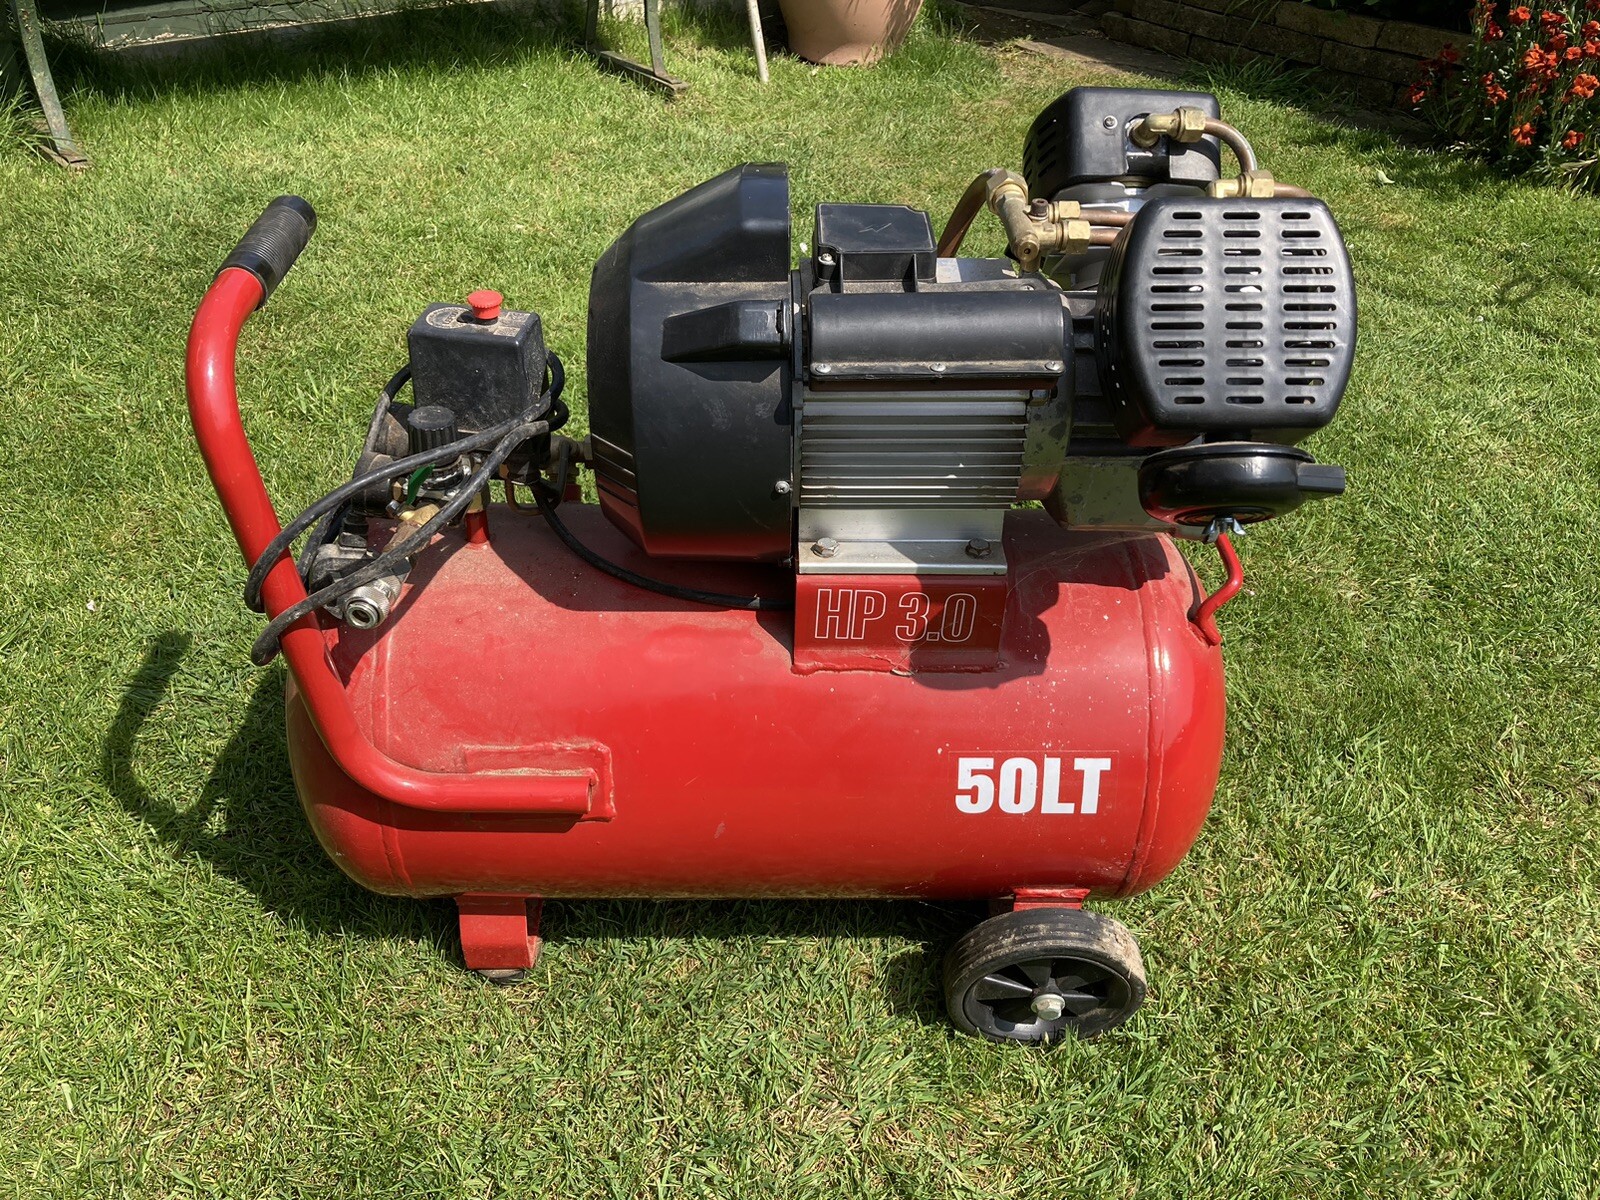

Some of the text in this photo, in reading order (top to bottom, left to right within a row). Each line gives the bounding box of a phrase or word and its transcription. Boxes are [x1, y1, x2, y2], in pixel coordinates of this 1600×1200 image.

[814, 588, 977, 642] HP 3.0
[954, 756, 1112, 815] 50LT
